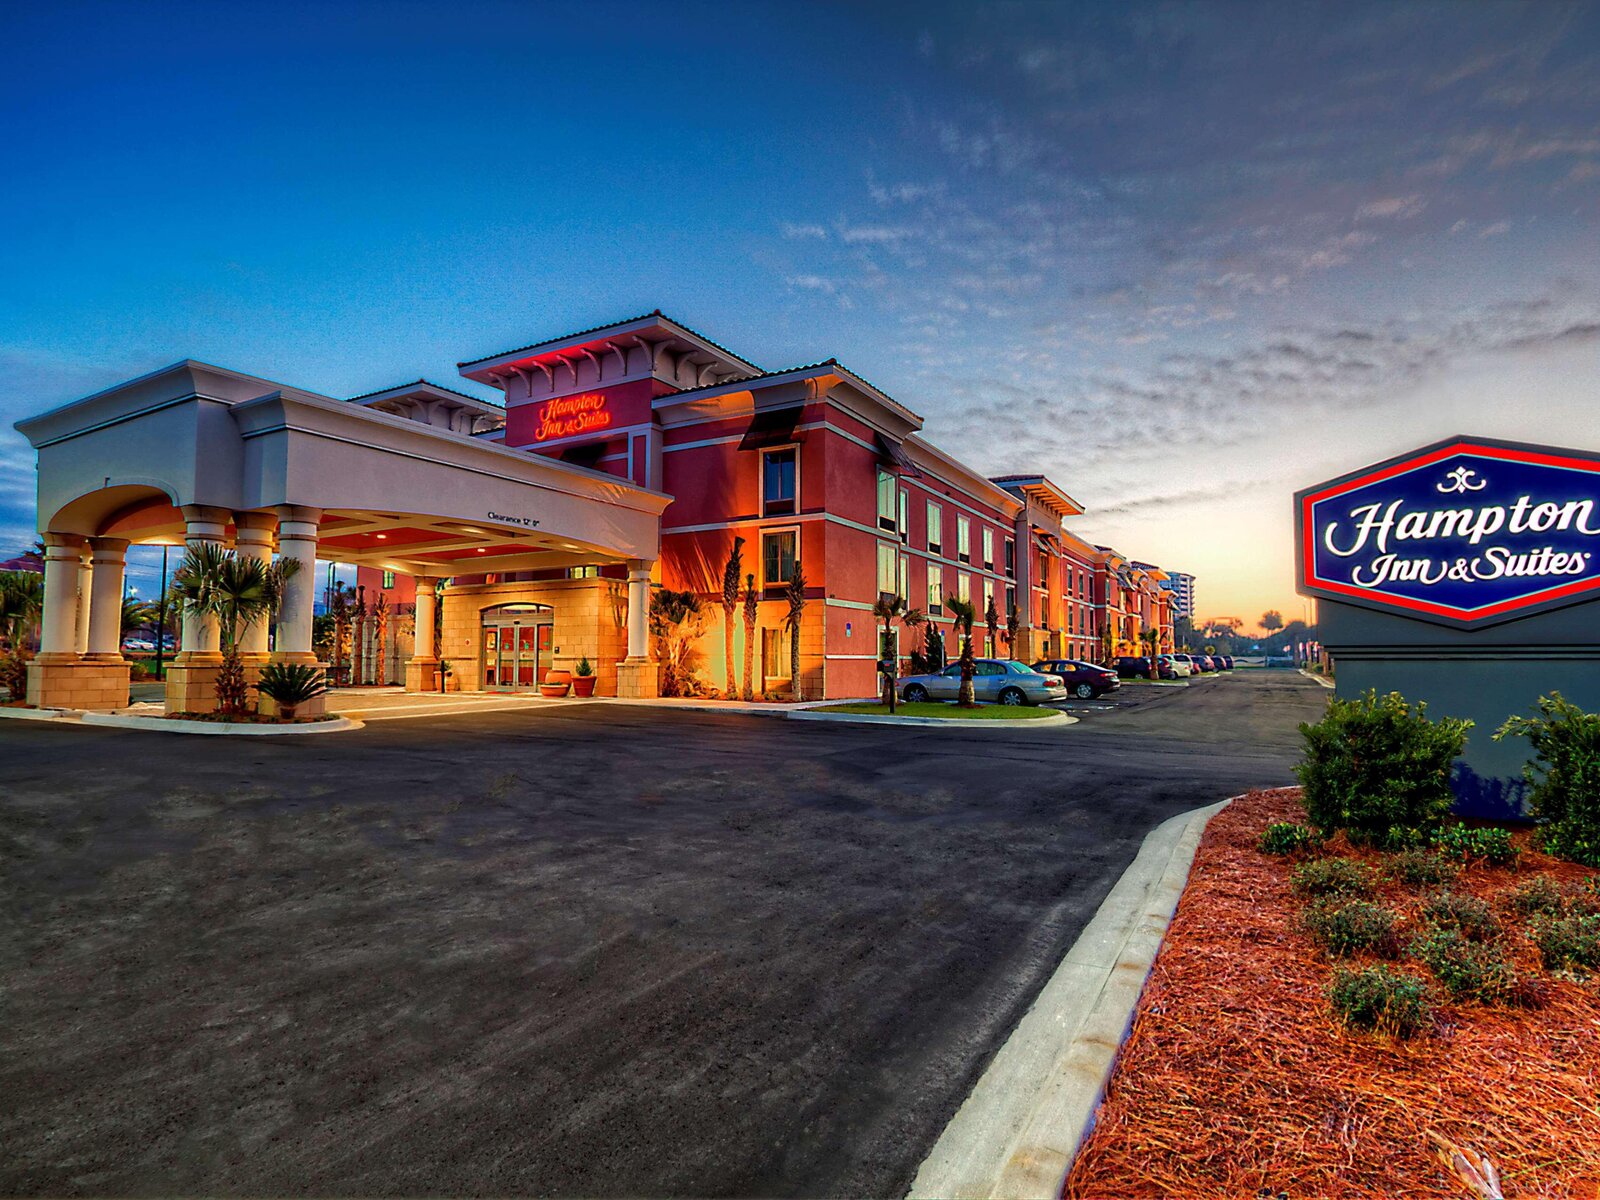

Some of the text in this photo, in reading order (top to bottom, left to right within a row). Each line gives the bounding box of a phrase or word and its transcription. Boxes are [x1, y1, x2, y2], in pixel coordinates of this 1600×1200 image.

[540, 395, 605, 421] Hampton
[536, 421, 565, 440] Inn
[575, 411, 609, 430] Suites
[488, 511, 521, 523] Clearance
[1325, 495, 1600, 557] Hampton
[1352, 553, 1448, 588] Inn
[1471, 547, 1586, 580] Suites
